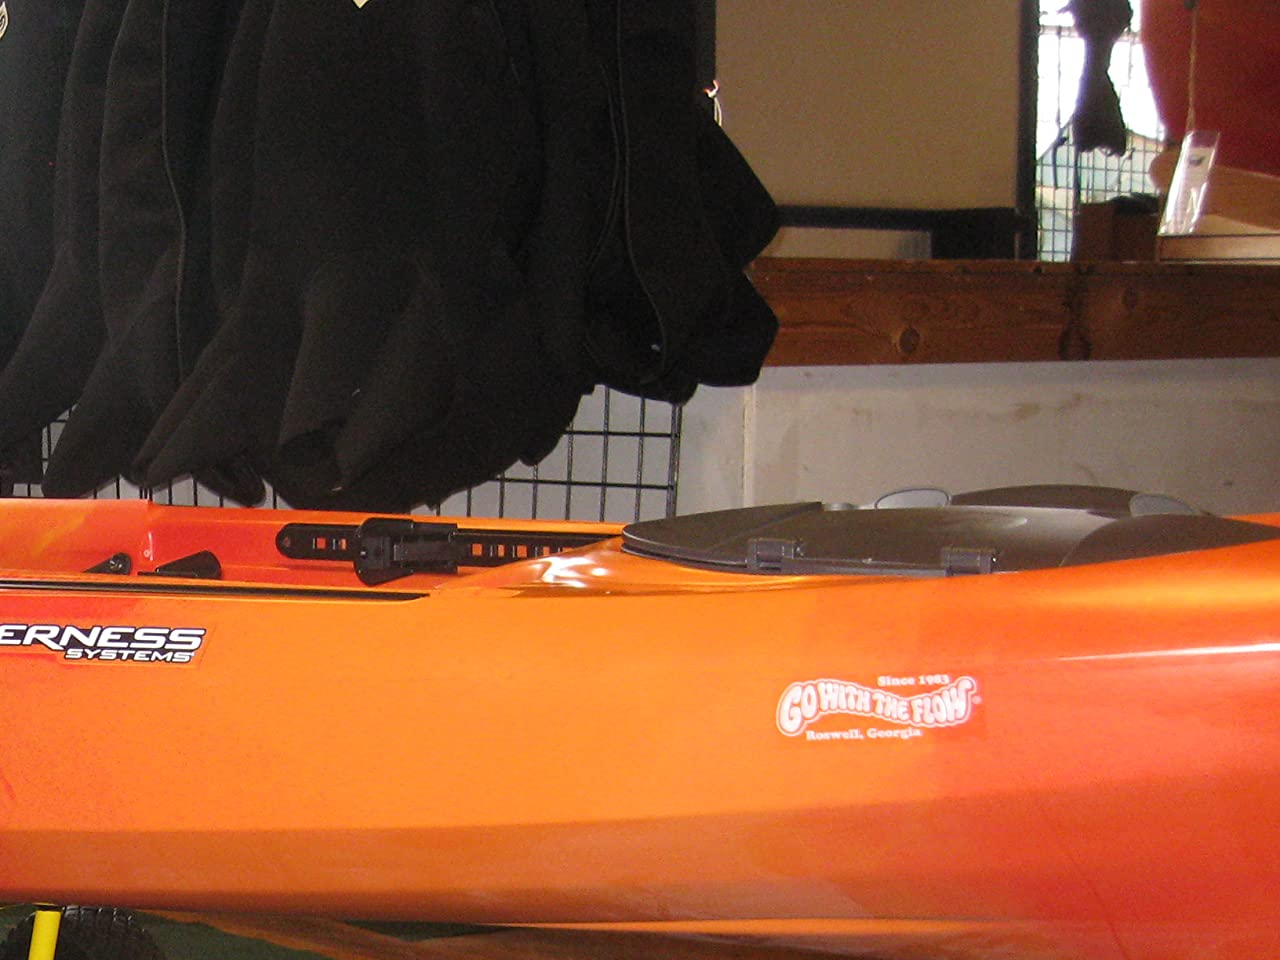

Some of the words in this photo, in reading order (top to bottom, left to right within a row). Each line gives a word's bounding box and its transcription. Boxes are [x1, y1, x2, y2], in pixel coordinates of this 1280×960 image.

[64, 648, 196, 664] SYSTEMS
[877, 674, 915, 687] Since
[779, 685, 817, 732] GO
[818, 682, 870, 712] WITH
[872, 691, 909, 721] THE
[910, 678, 972, 724] FLOW
[866, 727, 923, 740] Georgia
